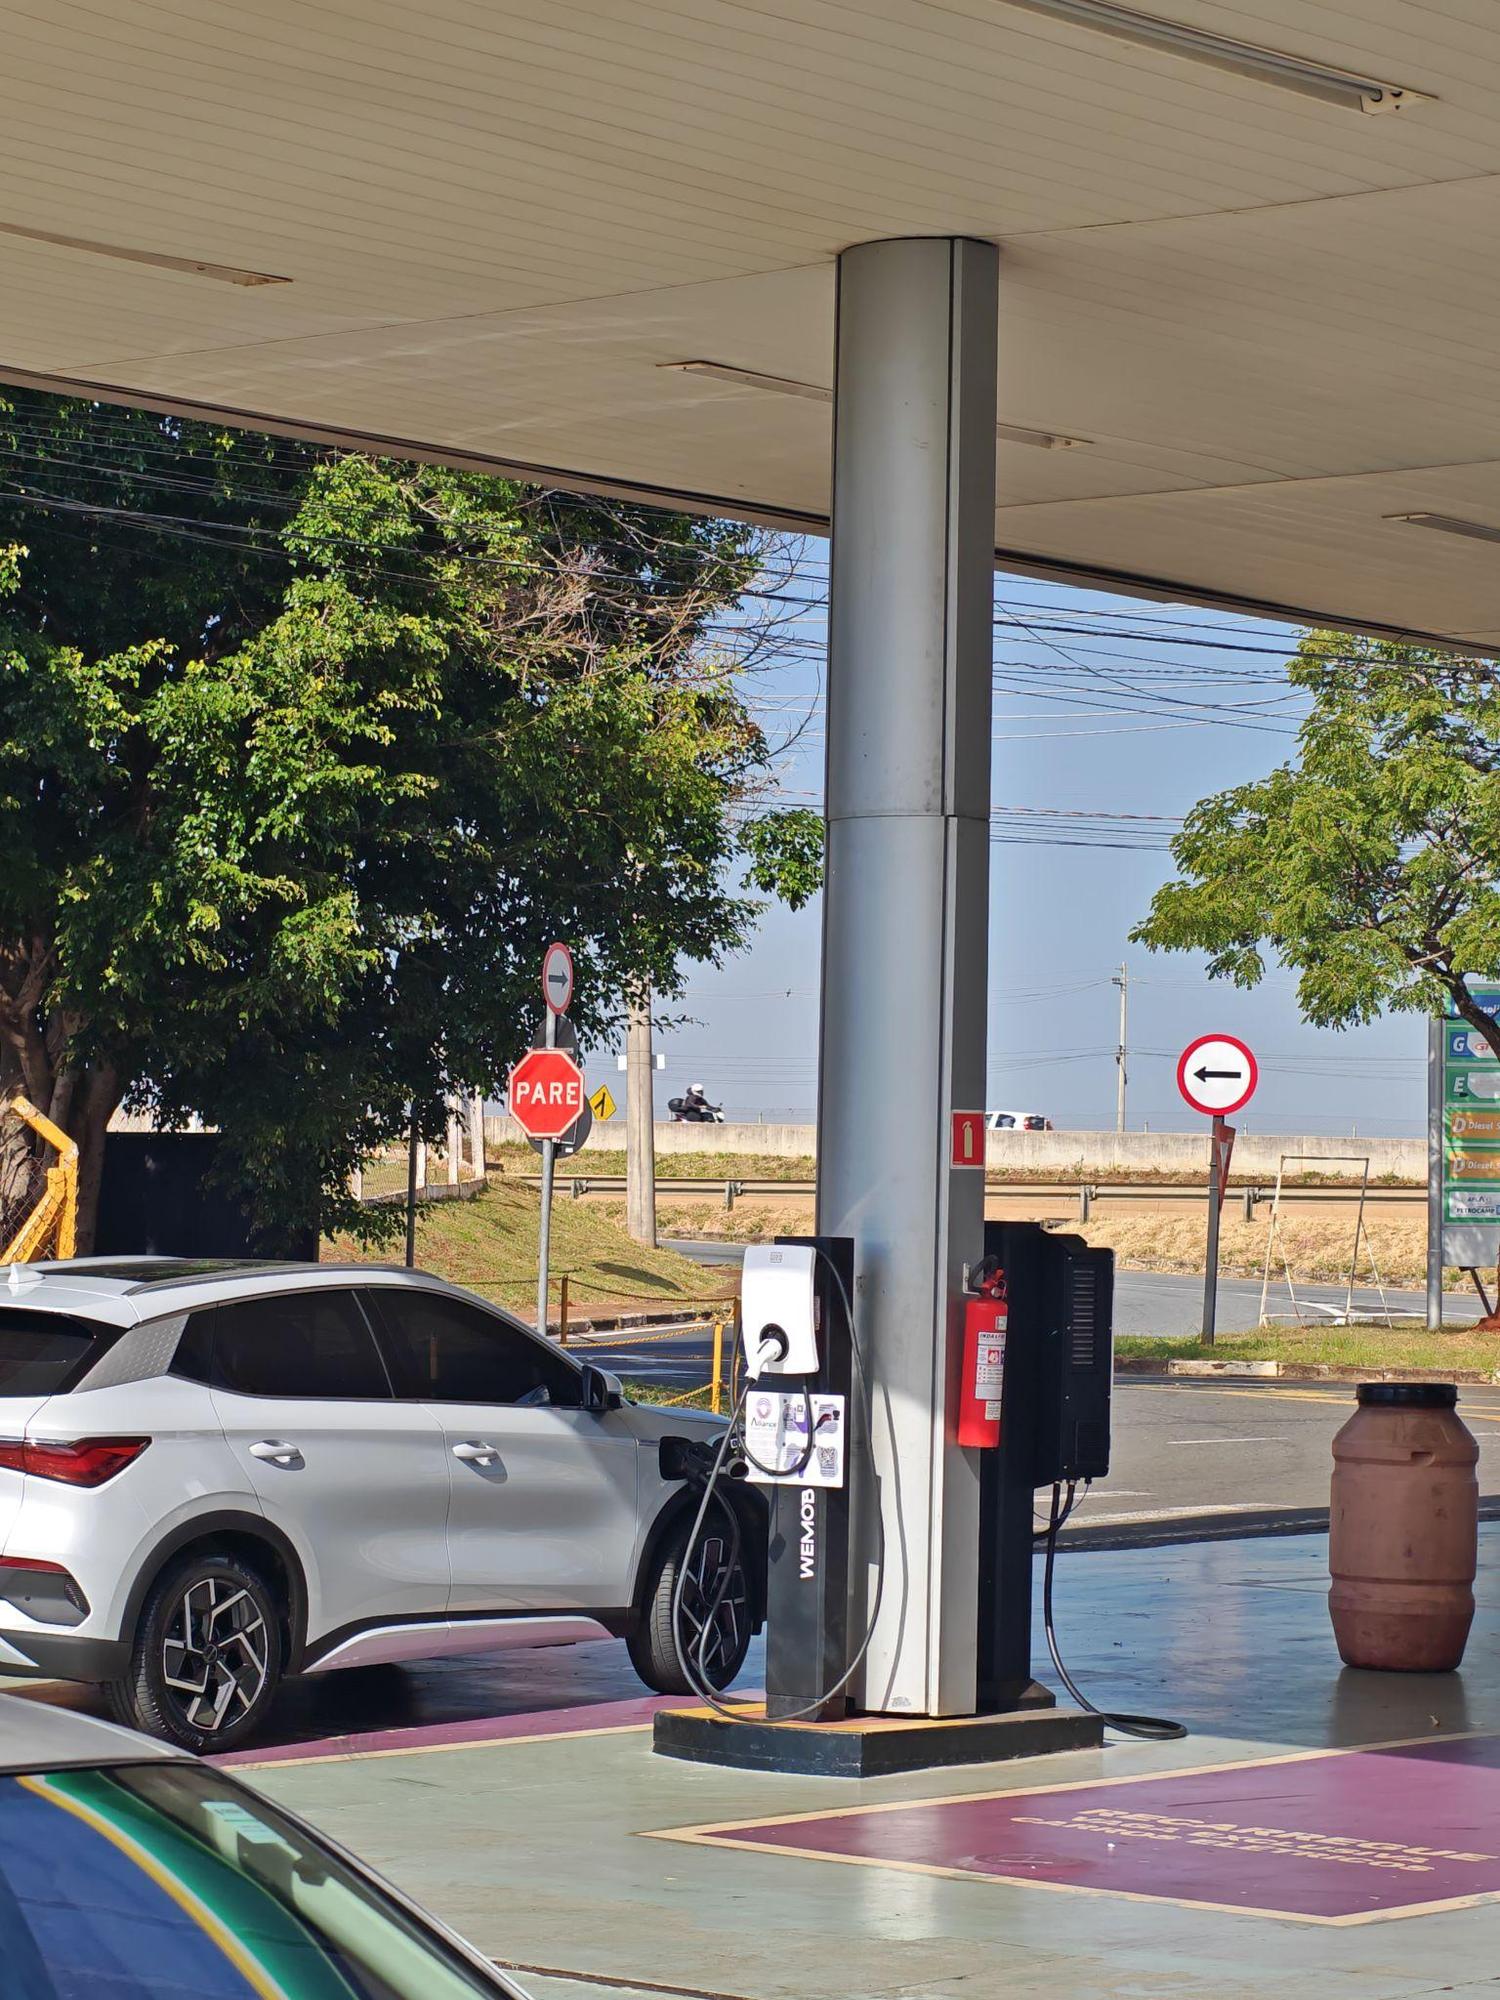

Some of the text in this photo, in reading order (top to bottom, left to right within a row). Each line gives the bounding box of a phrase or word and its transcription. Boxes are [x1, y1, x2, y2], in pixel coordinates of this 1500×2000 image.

[1453, 1036, 1466, 1052] G
[516, 1081, 579, 1105] PARE
[1453, 1076, 1466, 1093] E
[1452, 1117, 1467, 1133] D
[1468, 1121, 1494, 1130] Diesel
[1467, 1161, 1494, 1169] Diesel
[800, 1488, 815, 1579] WEMOB
[1010, 1816, 1436, 1872] CARROS ELETRICOS
[1071, 1815, 1430, 1863] VAGA EXCLUSIVA
[1077, 1808, 1499, 1862] RECARREGUE
